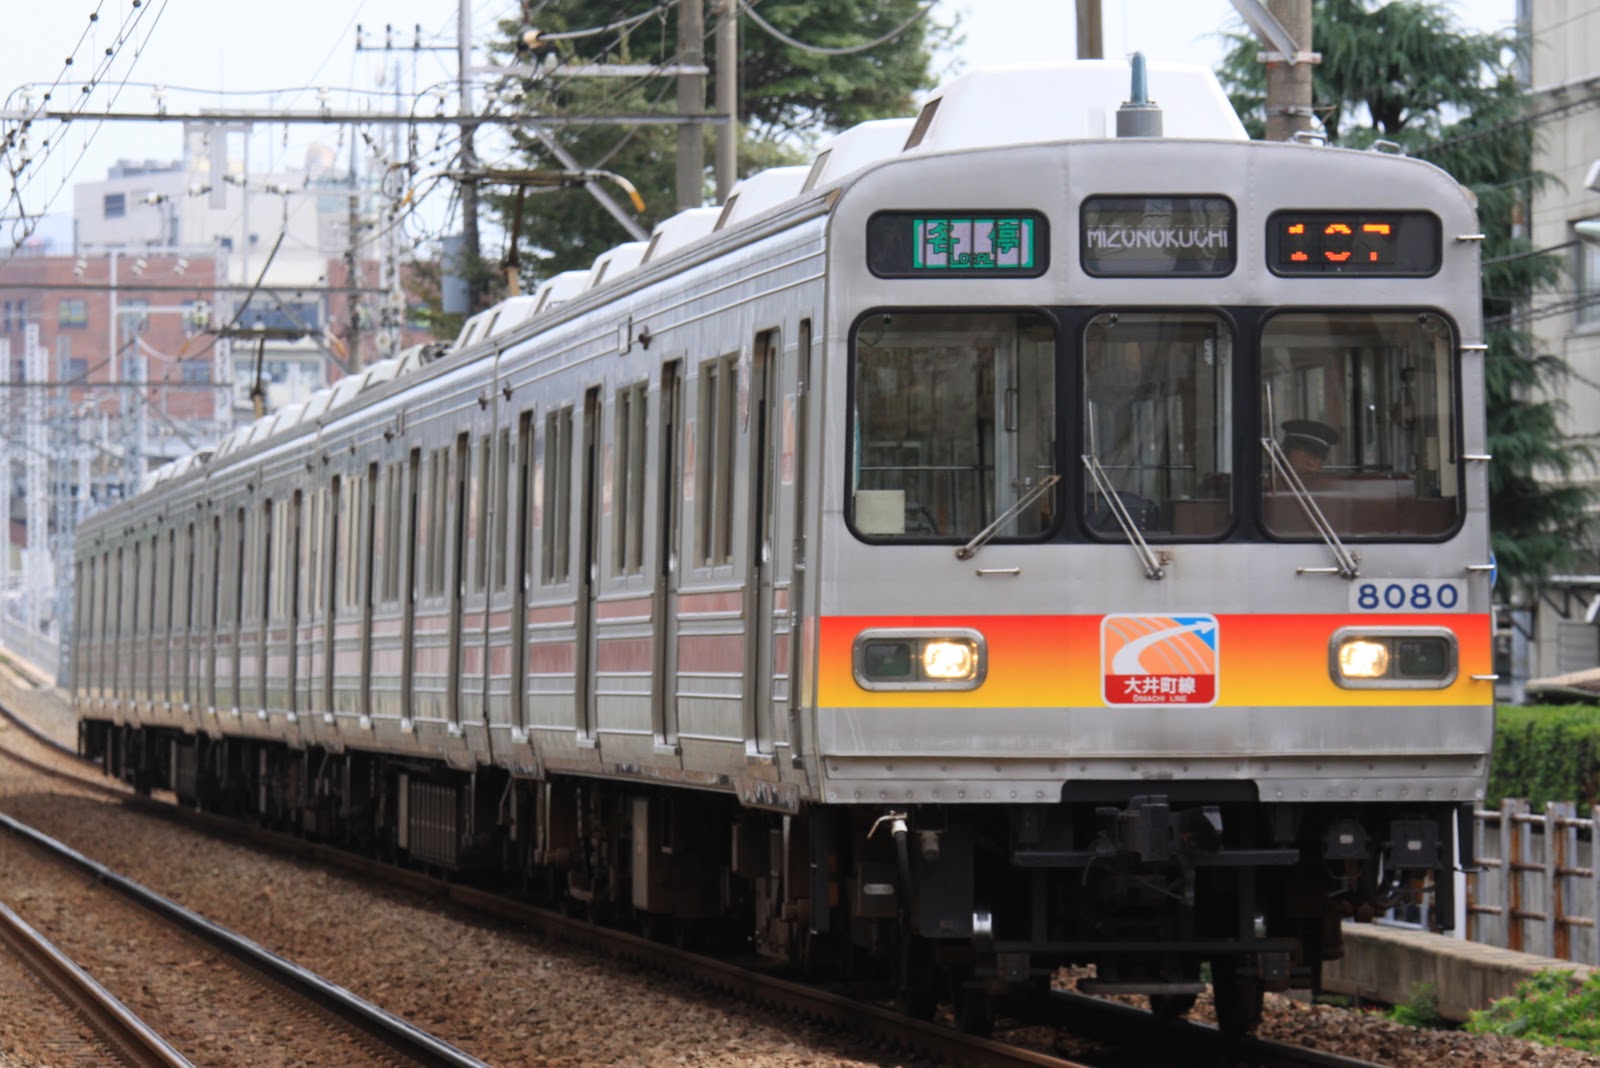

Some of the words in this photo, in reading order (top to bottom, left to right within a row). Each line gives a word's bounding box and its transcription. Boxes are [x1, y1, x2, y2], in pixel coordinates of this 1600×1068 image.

[927, 222, 1019, 254] 各停
[951, 252, 994, 265] LOCAL
[1357, 583, 1459, 610] 8080
[1123, 676, 1197, 694] 大井町線
[1169, 695, 1188, 703] LINE
